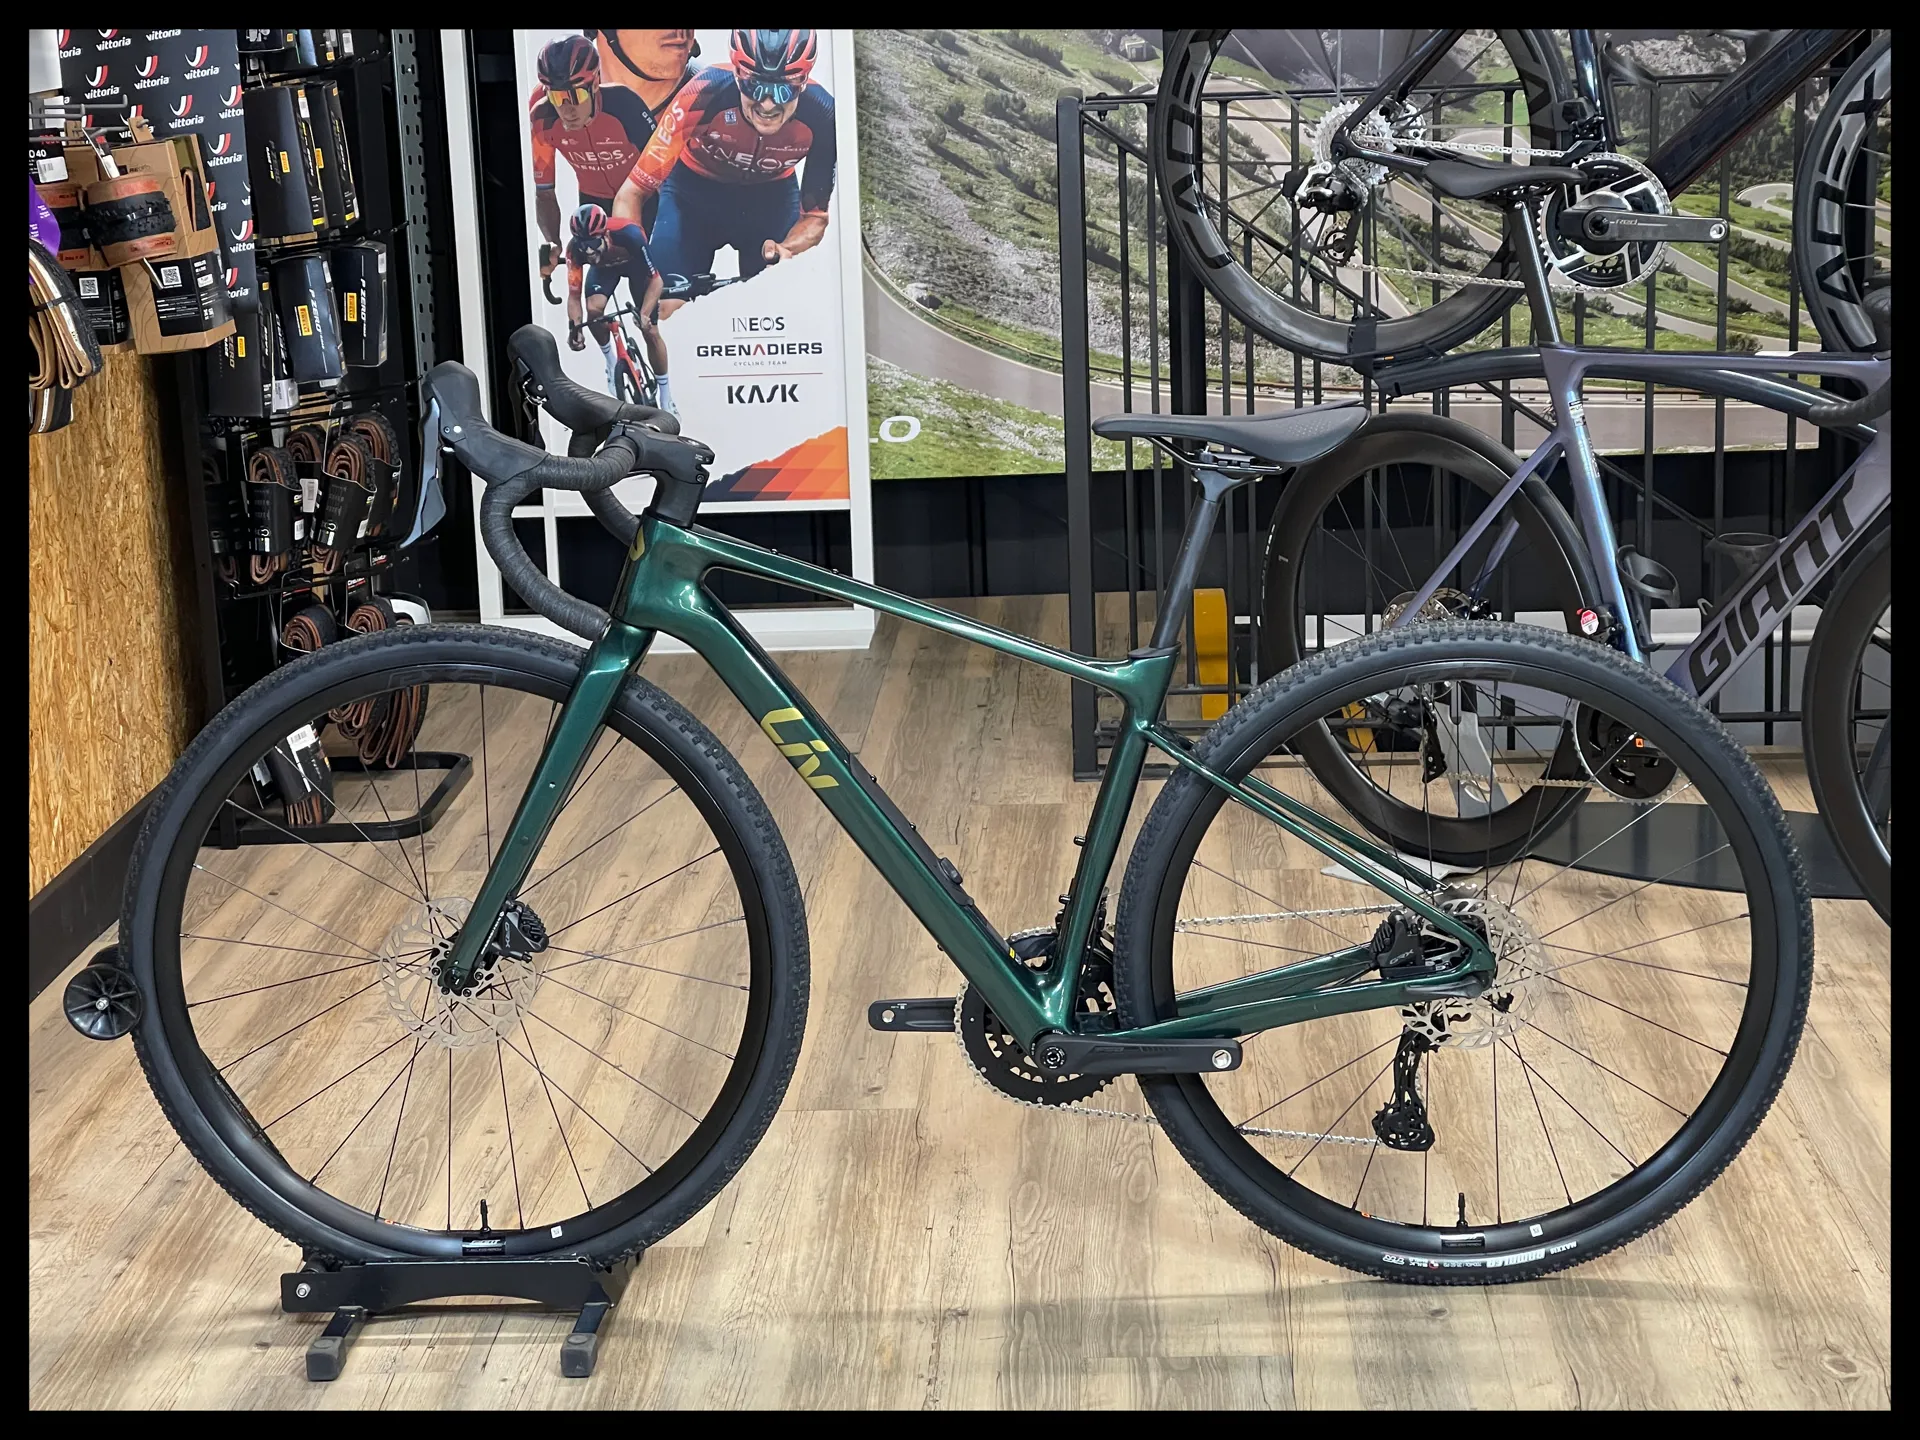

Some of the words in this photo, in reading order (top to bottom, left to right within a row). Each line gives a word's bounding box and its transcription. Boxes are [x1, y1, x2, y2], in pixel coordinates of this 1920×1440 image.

[60, 46, 82, 58] toria
[96, 37, 132, 52] vittoria
[184, 66, 220, 80] vittoria
[134, 76, 170, 90] vittoria
[85, 86, 120, 100] vittoria
[169, 115, 205, 130] vittoria
[207, 152, 243, 168] vittoria
[568, 150, 624, 162] INEOS
[210, 201, 227, 212] oria
[311, 299, 322, 333] ZERO
[731, 316, 785, 333] INEOS
[696, 342, 823, 358] GRENADIERS
[727, 384, 800, 404] KASK
[869, 415, 922, 444] O
[1689, 469, 1857, 697] GIANT
[1388, 948, 1415, 966] GRX
[1550, 1240, 1578, 1255] MAXXIS
